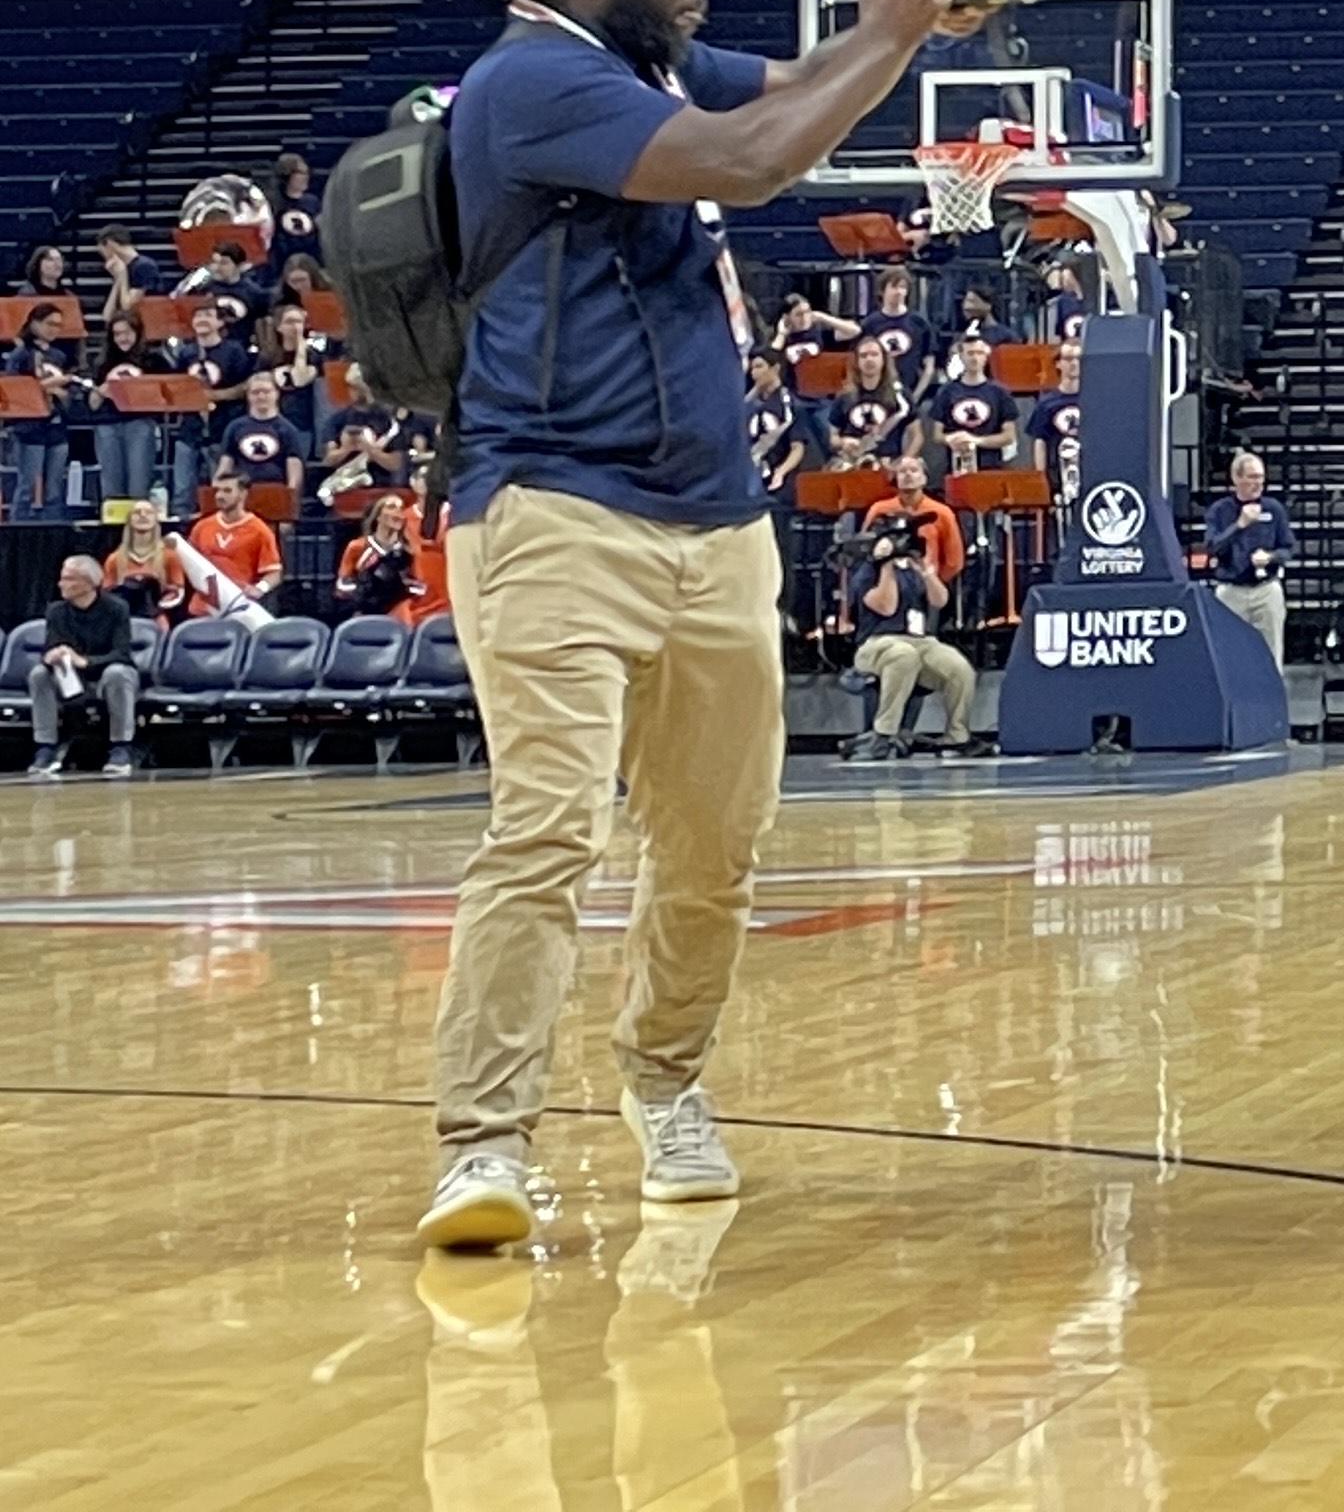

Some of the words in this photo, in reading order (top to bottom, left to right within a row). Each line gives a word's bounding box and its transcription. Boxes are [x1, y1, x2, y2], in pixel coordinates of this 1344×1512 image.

[1080, 561, 1143, 575] LOTTERY
[1070, 608, 1188, 638] UNITED
[1070, 639, 1155, 667] BANK
